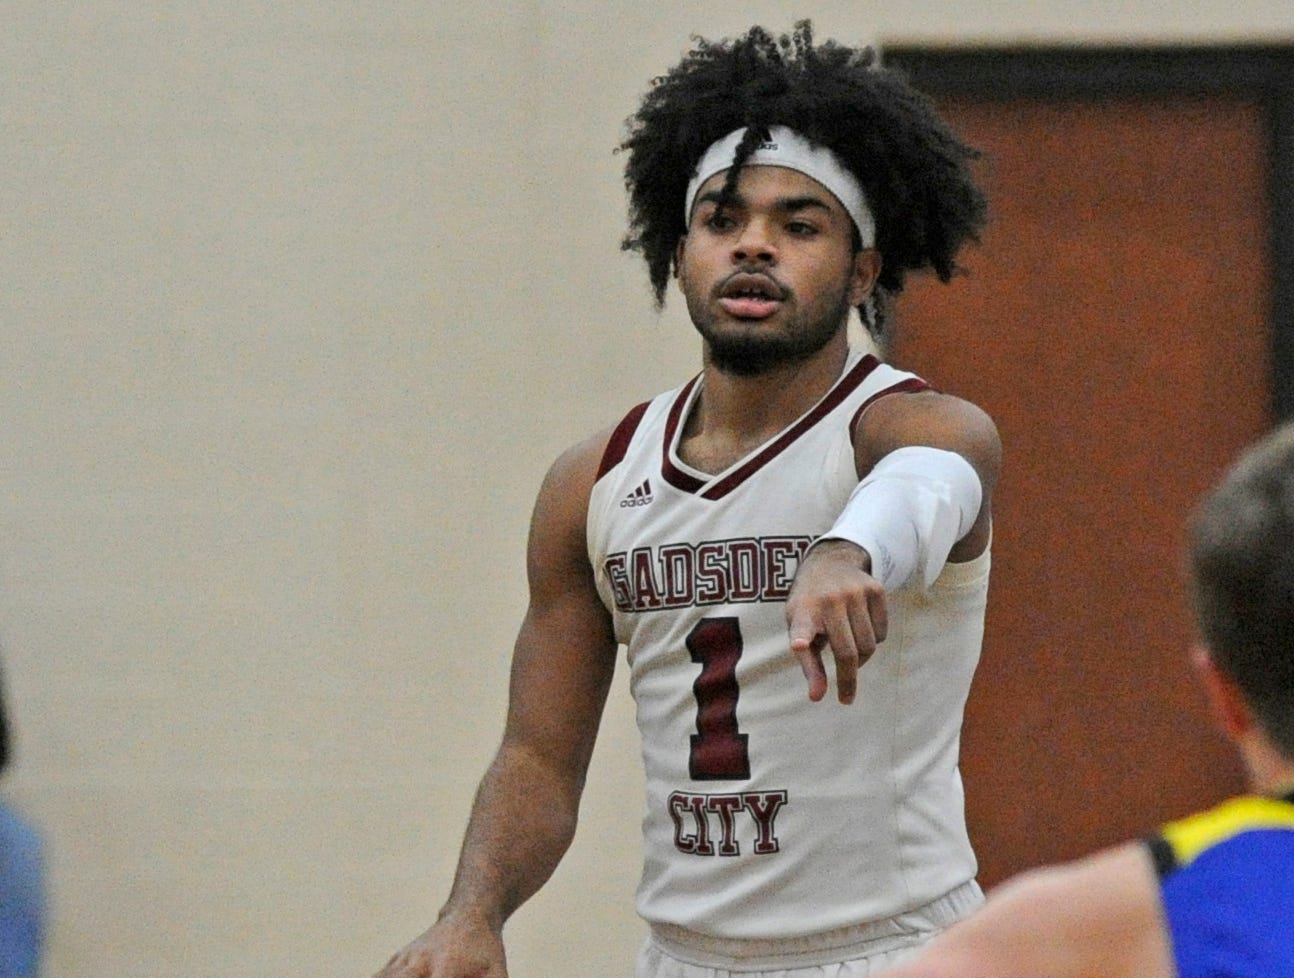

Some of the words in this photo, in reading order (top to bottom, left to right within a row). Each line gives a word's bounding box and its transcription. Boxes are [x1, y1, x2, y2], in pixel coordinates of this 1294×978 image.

[603, 535, 822, 613] GADSDE
[685, 616, 751, 780] 1
[667, 789, 788, 856] CITY
